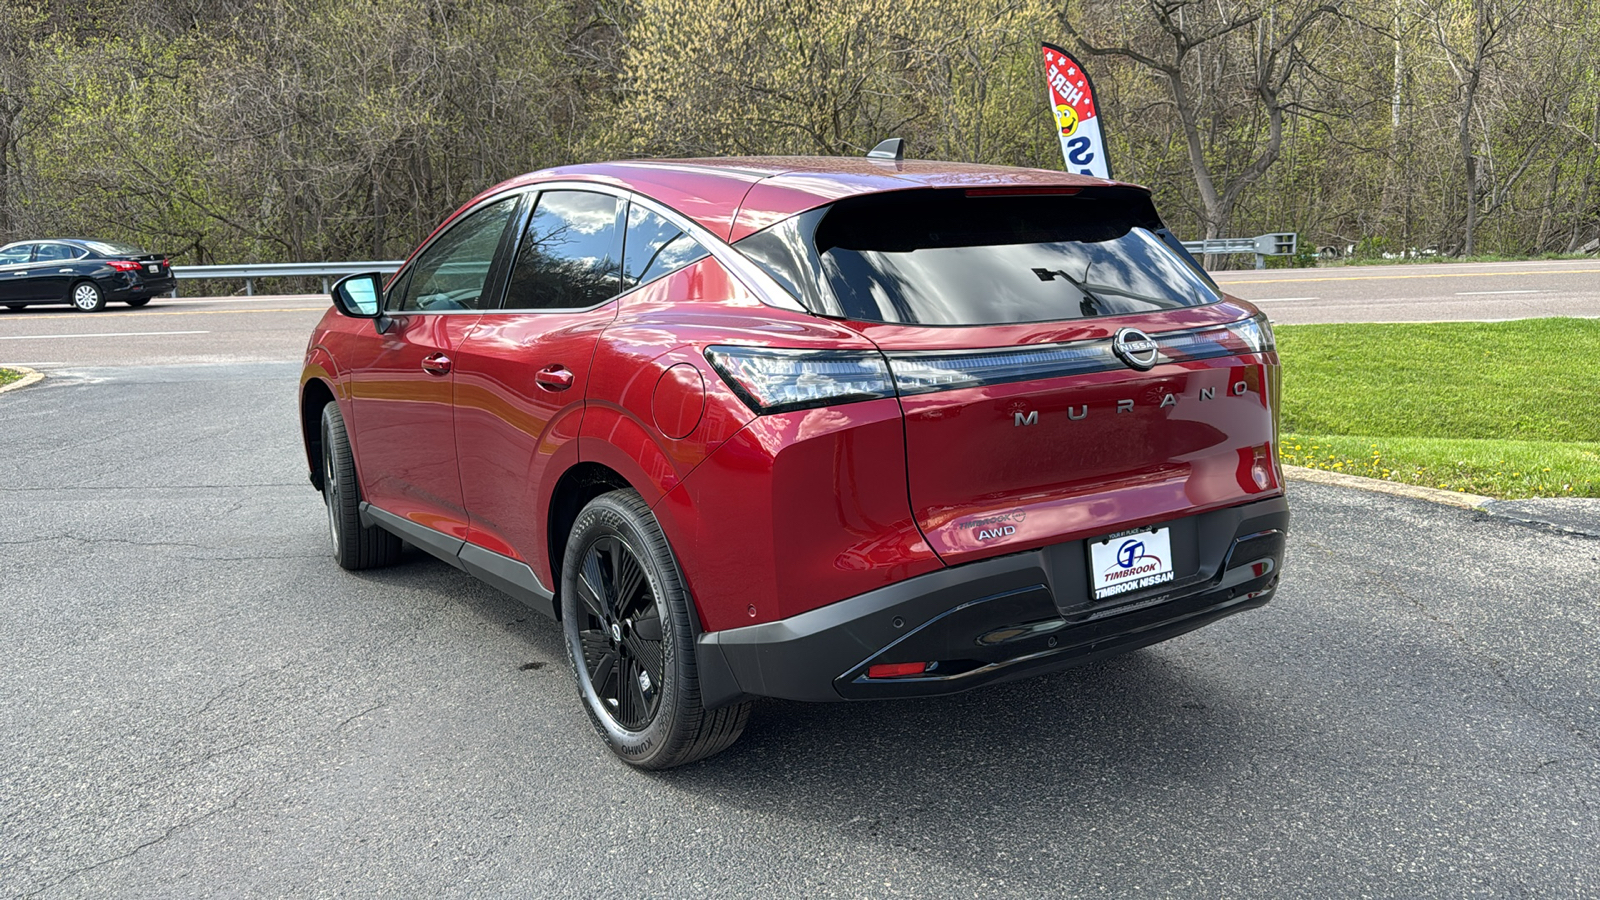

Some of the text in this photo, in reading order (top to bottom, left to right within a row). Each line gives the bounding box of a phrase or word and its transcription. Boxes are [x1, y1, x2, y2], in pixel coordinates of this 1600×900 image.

[1120, 340, 1158, 351] NISSAN
[1014, 380, 1248, 427] MURANO
[959, 513, 1011, 530] TIMBROOK
[978, 525, 1016, 541] AWD
[1104, 562, 1157, 582] TIMBROOK
[1095, 571, 1174, 600] TIMBROOK NISSAN
[621, 737, 653, 755] KUMHO
